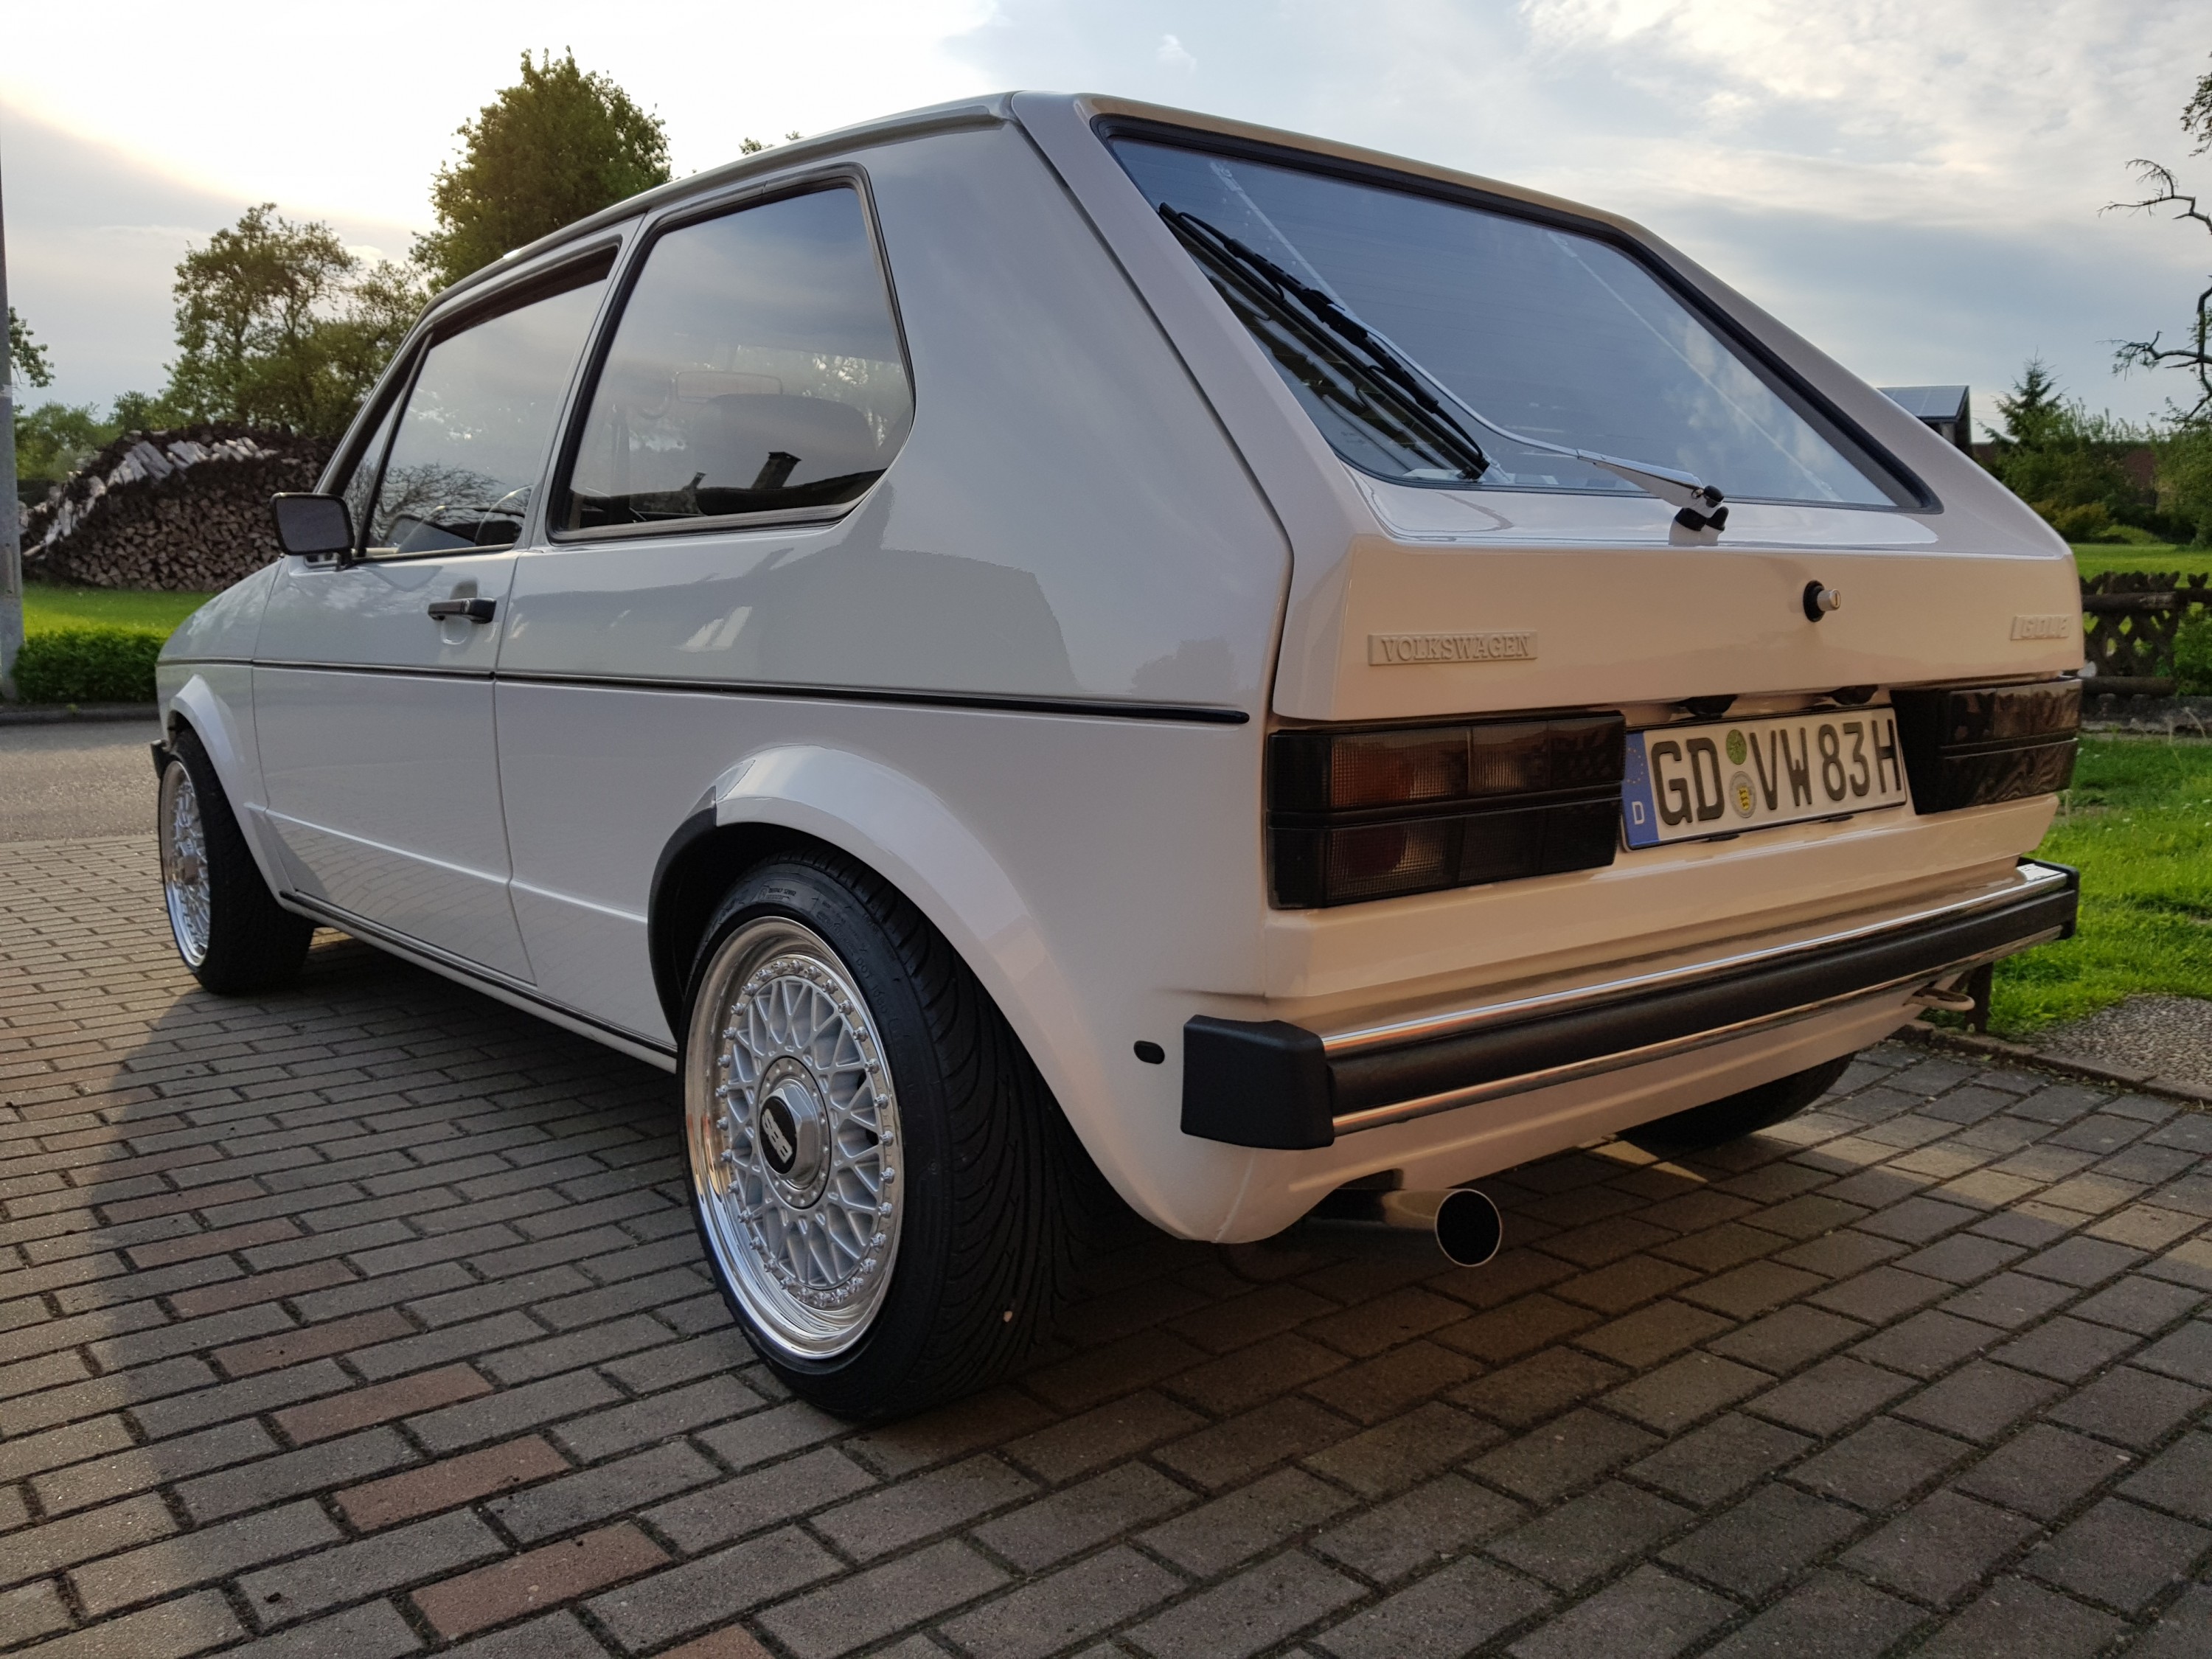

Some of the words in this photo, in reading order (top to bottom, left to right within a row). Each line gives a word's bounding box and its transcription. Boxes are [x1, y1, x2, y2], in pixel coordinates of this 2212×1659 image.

[1381, 633, 1531, 662] VOLKSWAGEN
[1651, 737, 1725, 826] GD
[1631, 801, 1646, 826] D
[762, 1108, 793, 1164] BBS
